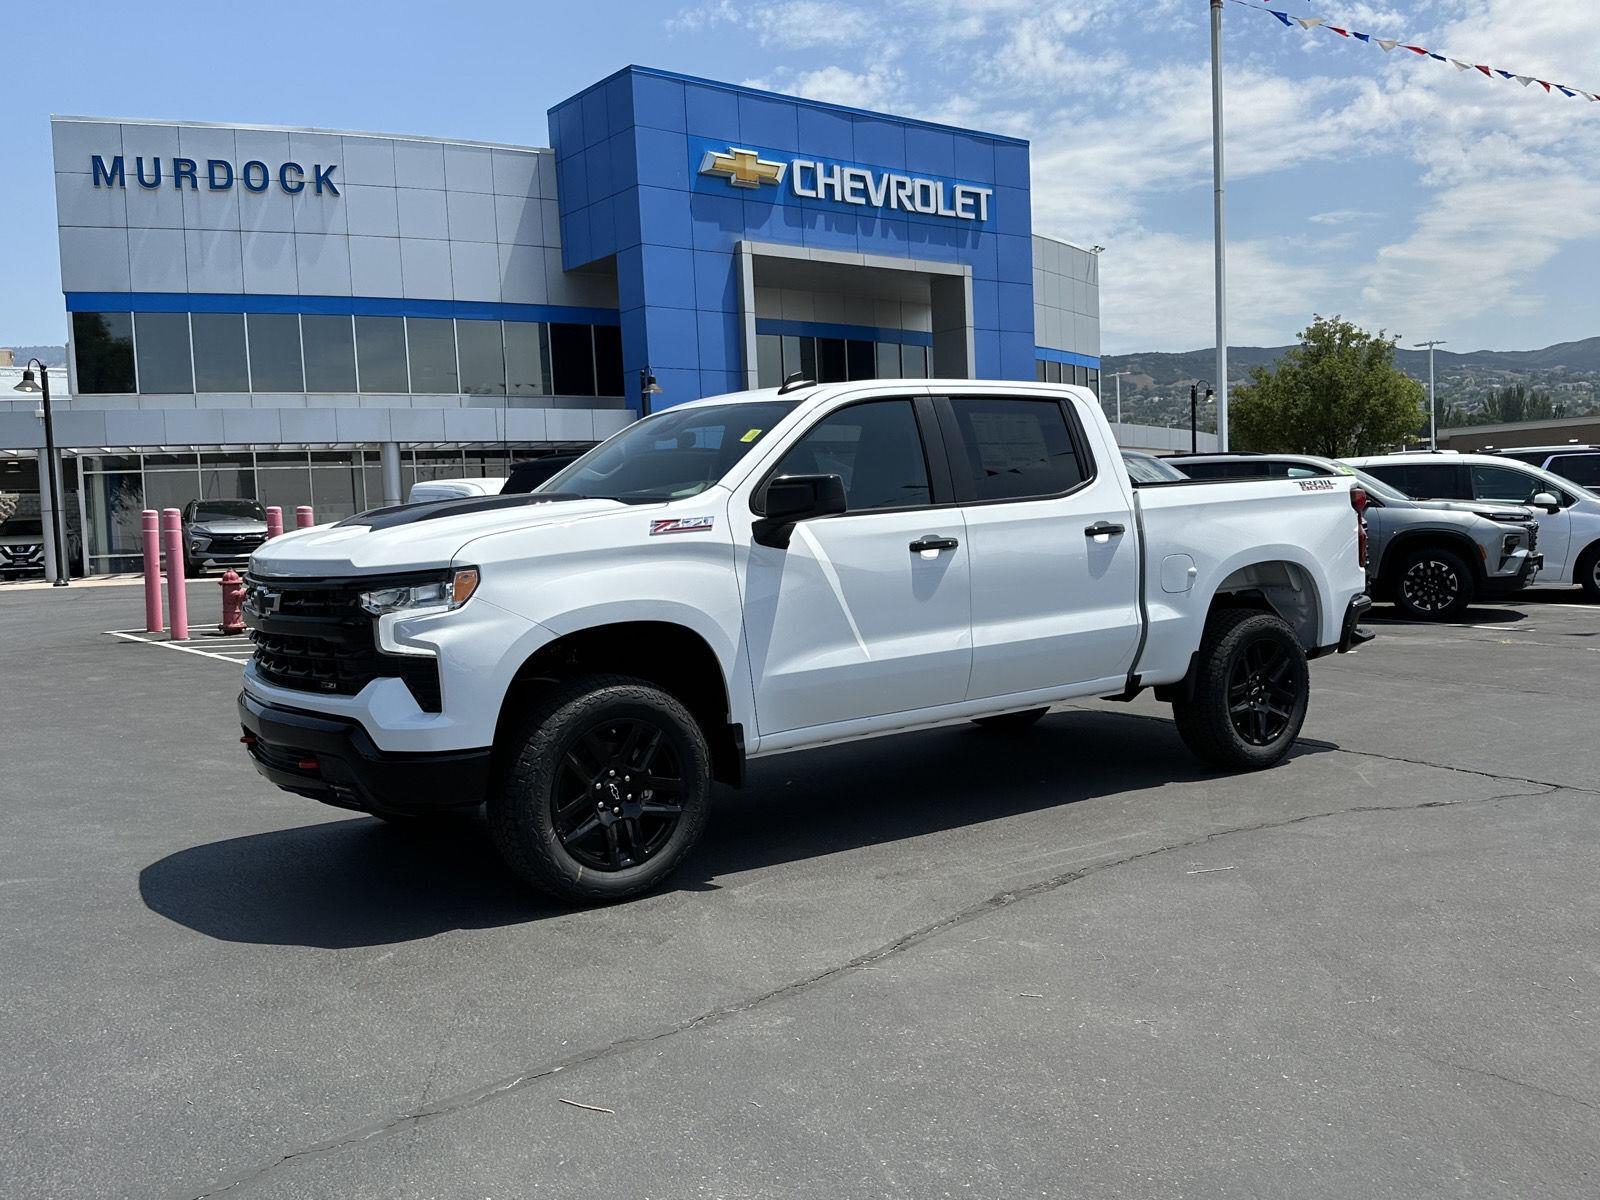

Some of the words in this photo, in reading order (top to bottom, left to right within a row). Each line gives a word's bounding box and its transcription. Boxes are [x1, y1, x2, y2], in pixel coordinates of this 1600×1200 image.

[91, 154, 341, 197] MURDOCK
[791, 158, 993, 221] CHEVROLET
[648, 516, 714, 536] Z71
